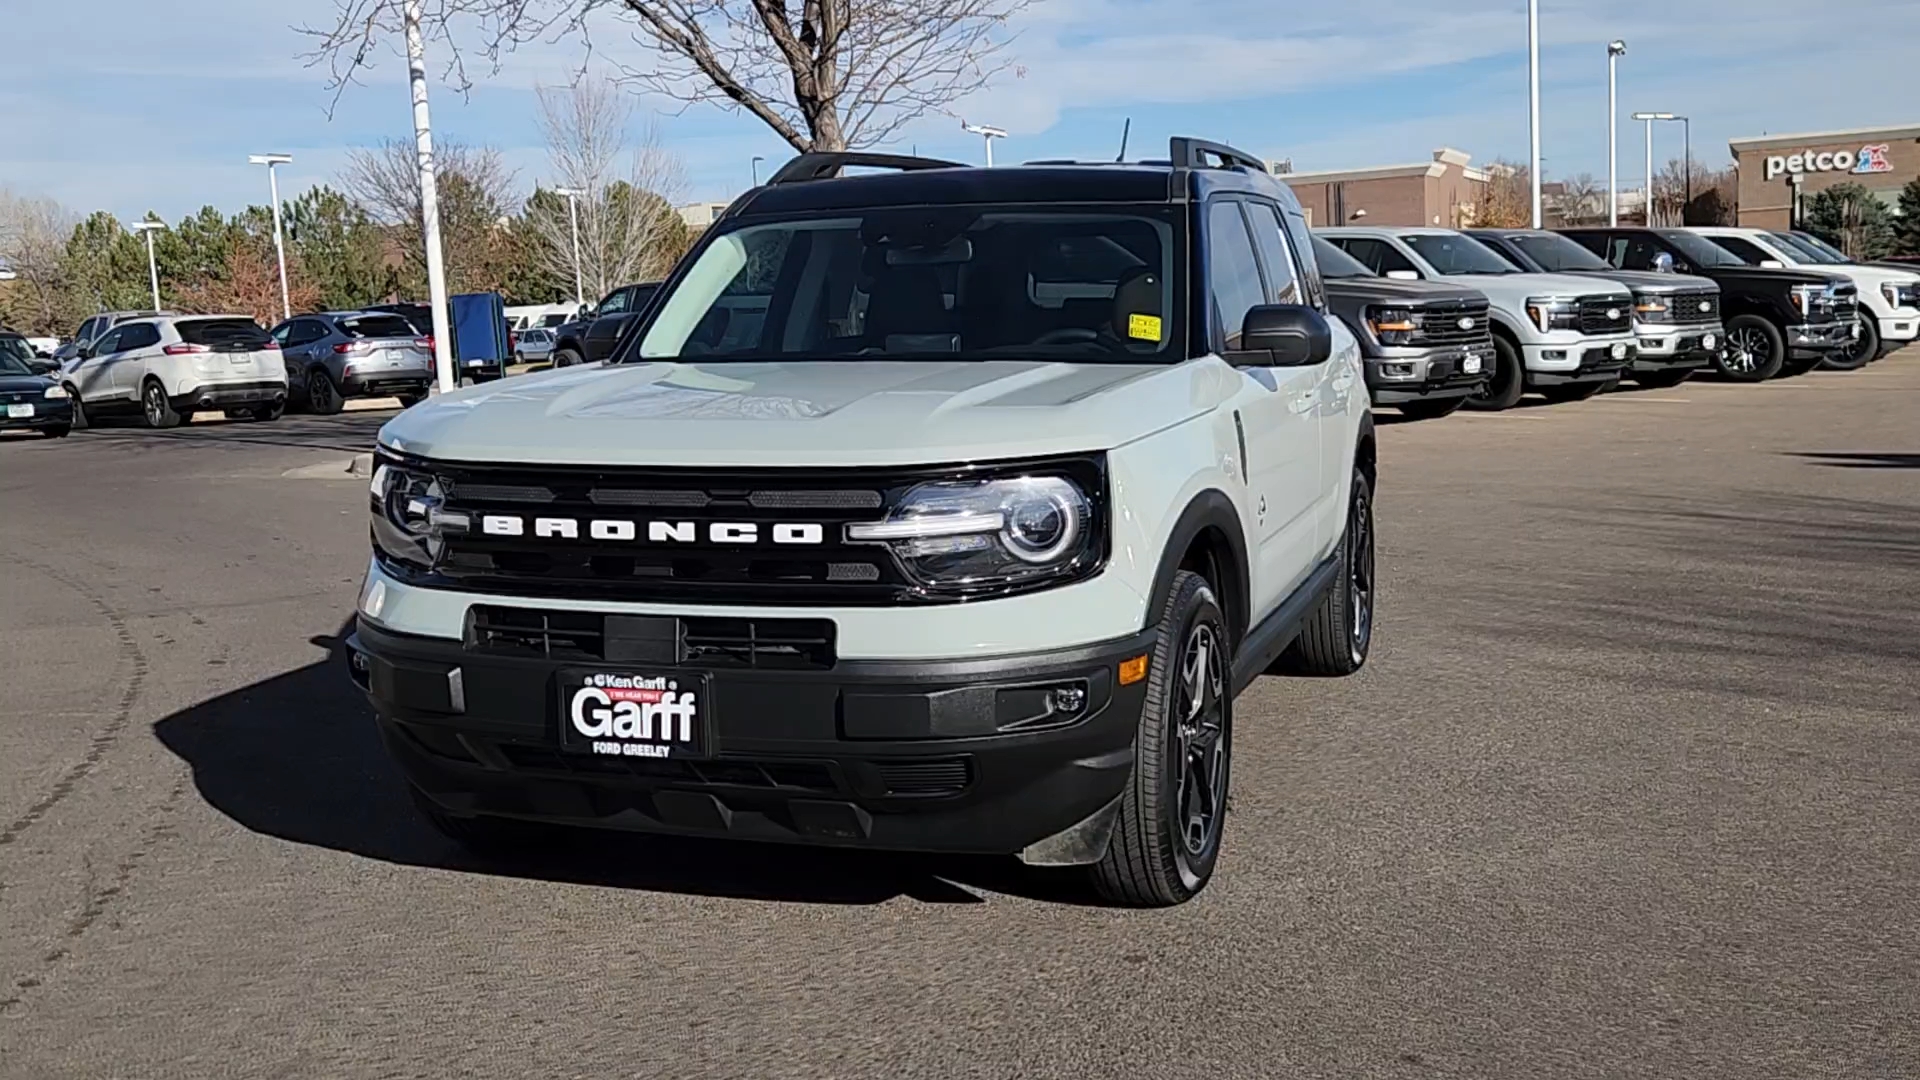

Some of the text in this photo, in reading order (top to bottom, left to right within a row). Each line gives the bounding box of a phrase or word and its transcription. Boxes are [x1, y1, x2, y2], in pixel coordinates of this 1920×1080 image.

[1767, 149, 1854, 180] petco
[483, 515, 823, 544] BRONCO
[606, 674, 666, 690] Ken Garff
[571, 687, 696, 742] Garff
[592, 742, 670, 758] FORD GREELEY
